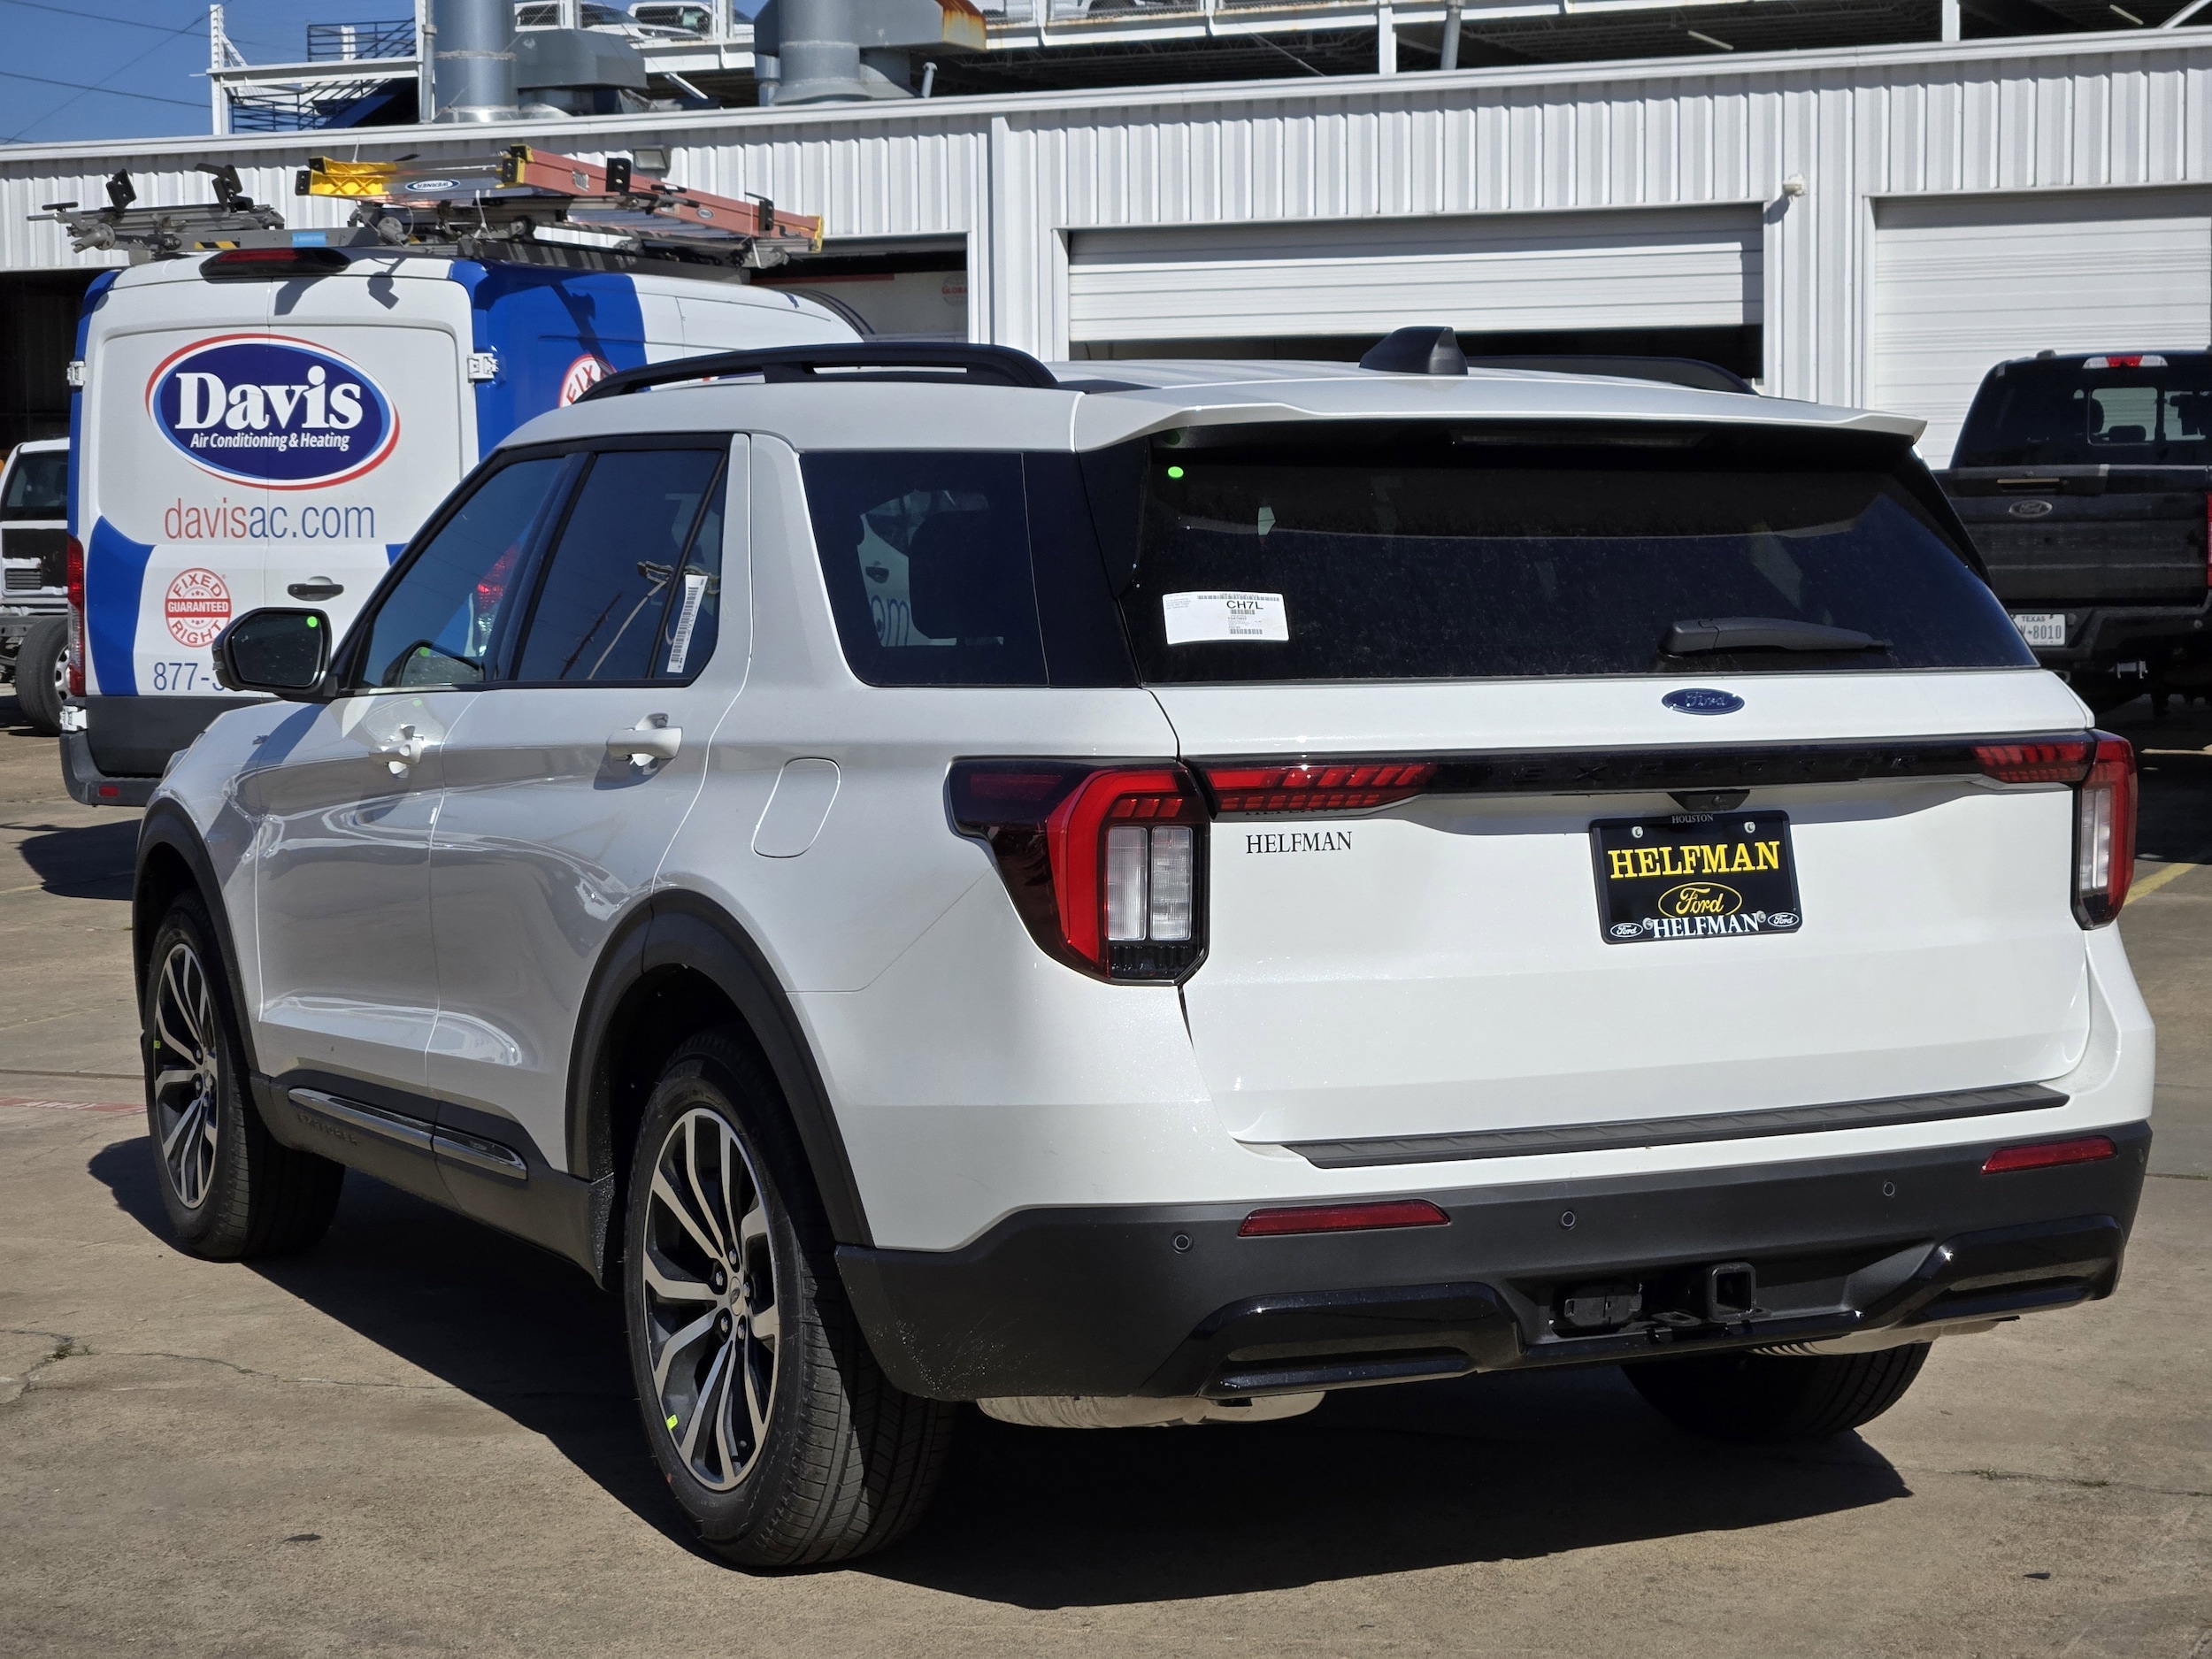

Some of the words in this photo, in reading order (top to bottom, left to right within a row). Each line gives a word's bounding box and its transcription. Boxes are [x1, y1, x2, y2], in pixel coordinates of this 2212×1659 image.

[174, 365, 364, 430] Davis
[190, 433, 209, 449] Air
[210, 432, 288, 452] Conditioning
[288, 433, 299, 449] &
[301, 432, 350, 452] Heating
[165, 497, 375, 539] davisac.com
[173, 572, 223, 598] FIXED
[167, 601, 229, 613] GUARANTEED
[1226, 600, 1263, 610] CH7L
[172, 619, 222, 644] RIGHT
[1685, 690, 1728, 707] Ford
[1671, 813, 1714, 824] HOUSTON
[1246, 831, 1352, 854] HELFMAN
[1608, 841, 1780, 879] HELFMAN
[1675, 887, 1724, 915] Ford
[1652, 912, 1759, 938] HELFMAN
